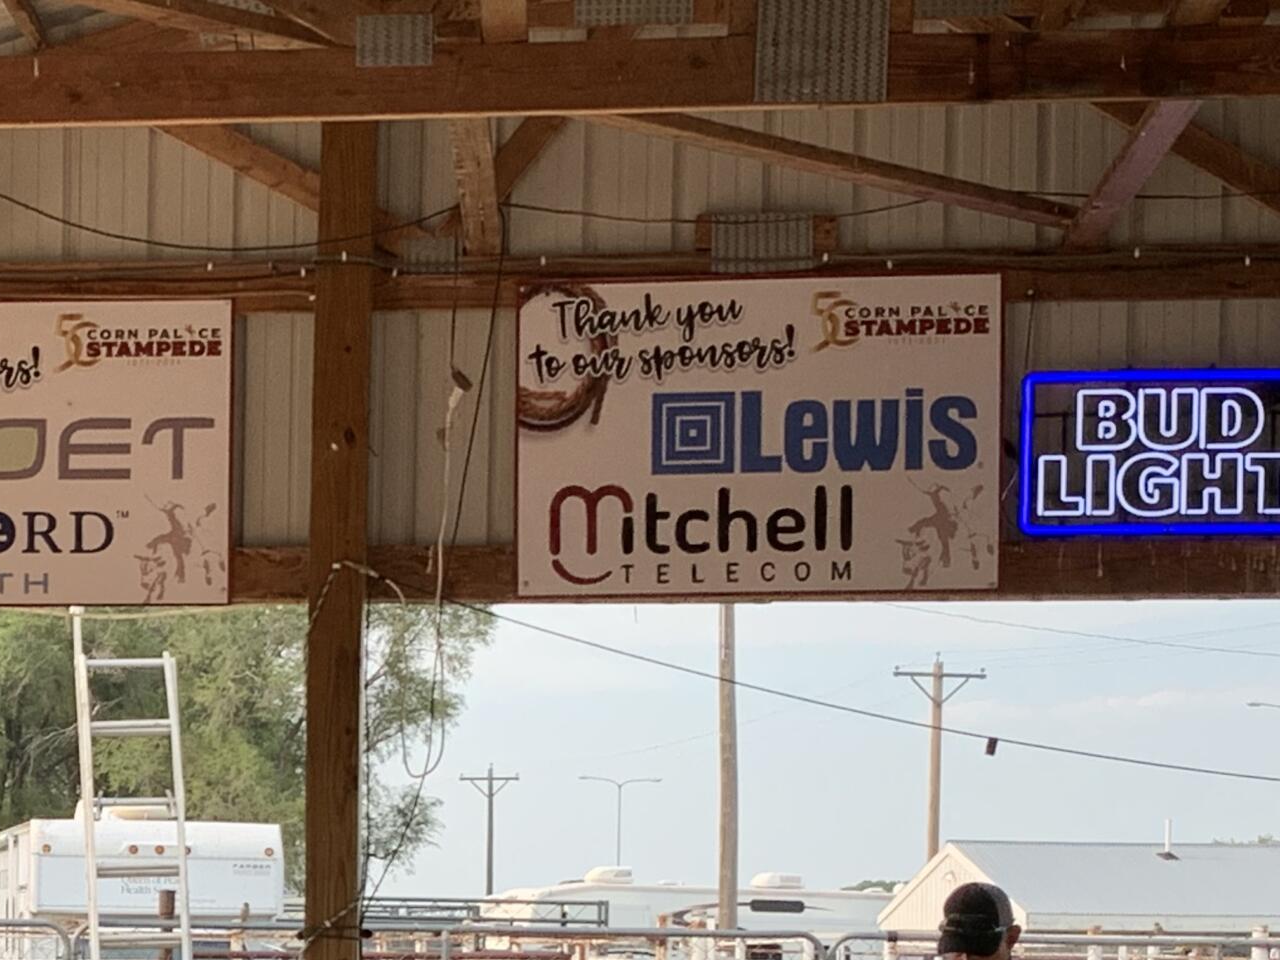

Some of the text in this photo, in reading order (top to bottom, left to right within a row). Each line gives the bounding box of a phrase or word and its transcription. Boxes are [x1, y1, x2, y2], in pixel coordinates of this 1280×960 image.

[554, 294, 743, 342] Thank you
[844, 317, 990, 337] STAMPEDE
[845, 301, 988, 319] CORN PALCE
[86, 324, 222, 341] CORN PALCE
[86, 340, 223, 358] STAMPEDE
[529, 324, 796, 384] to our sponsors!
[740, 388, 978, 474] Lewis
[1076, 386, 1265, 452] BUD
[1037, 451, 1280, 518] LIGHT
[621, 561, 853, 585] TELECOM
